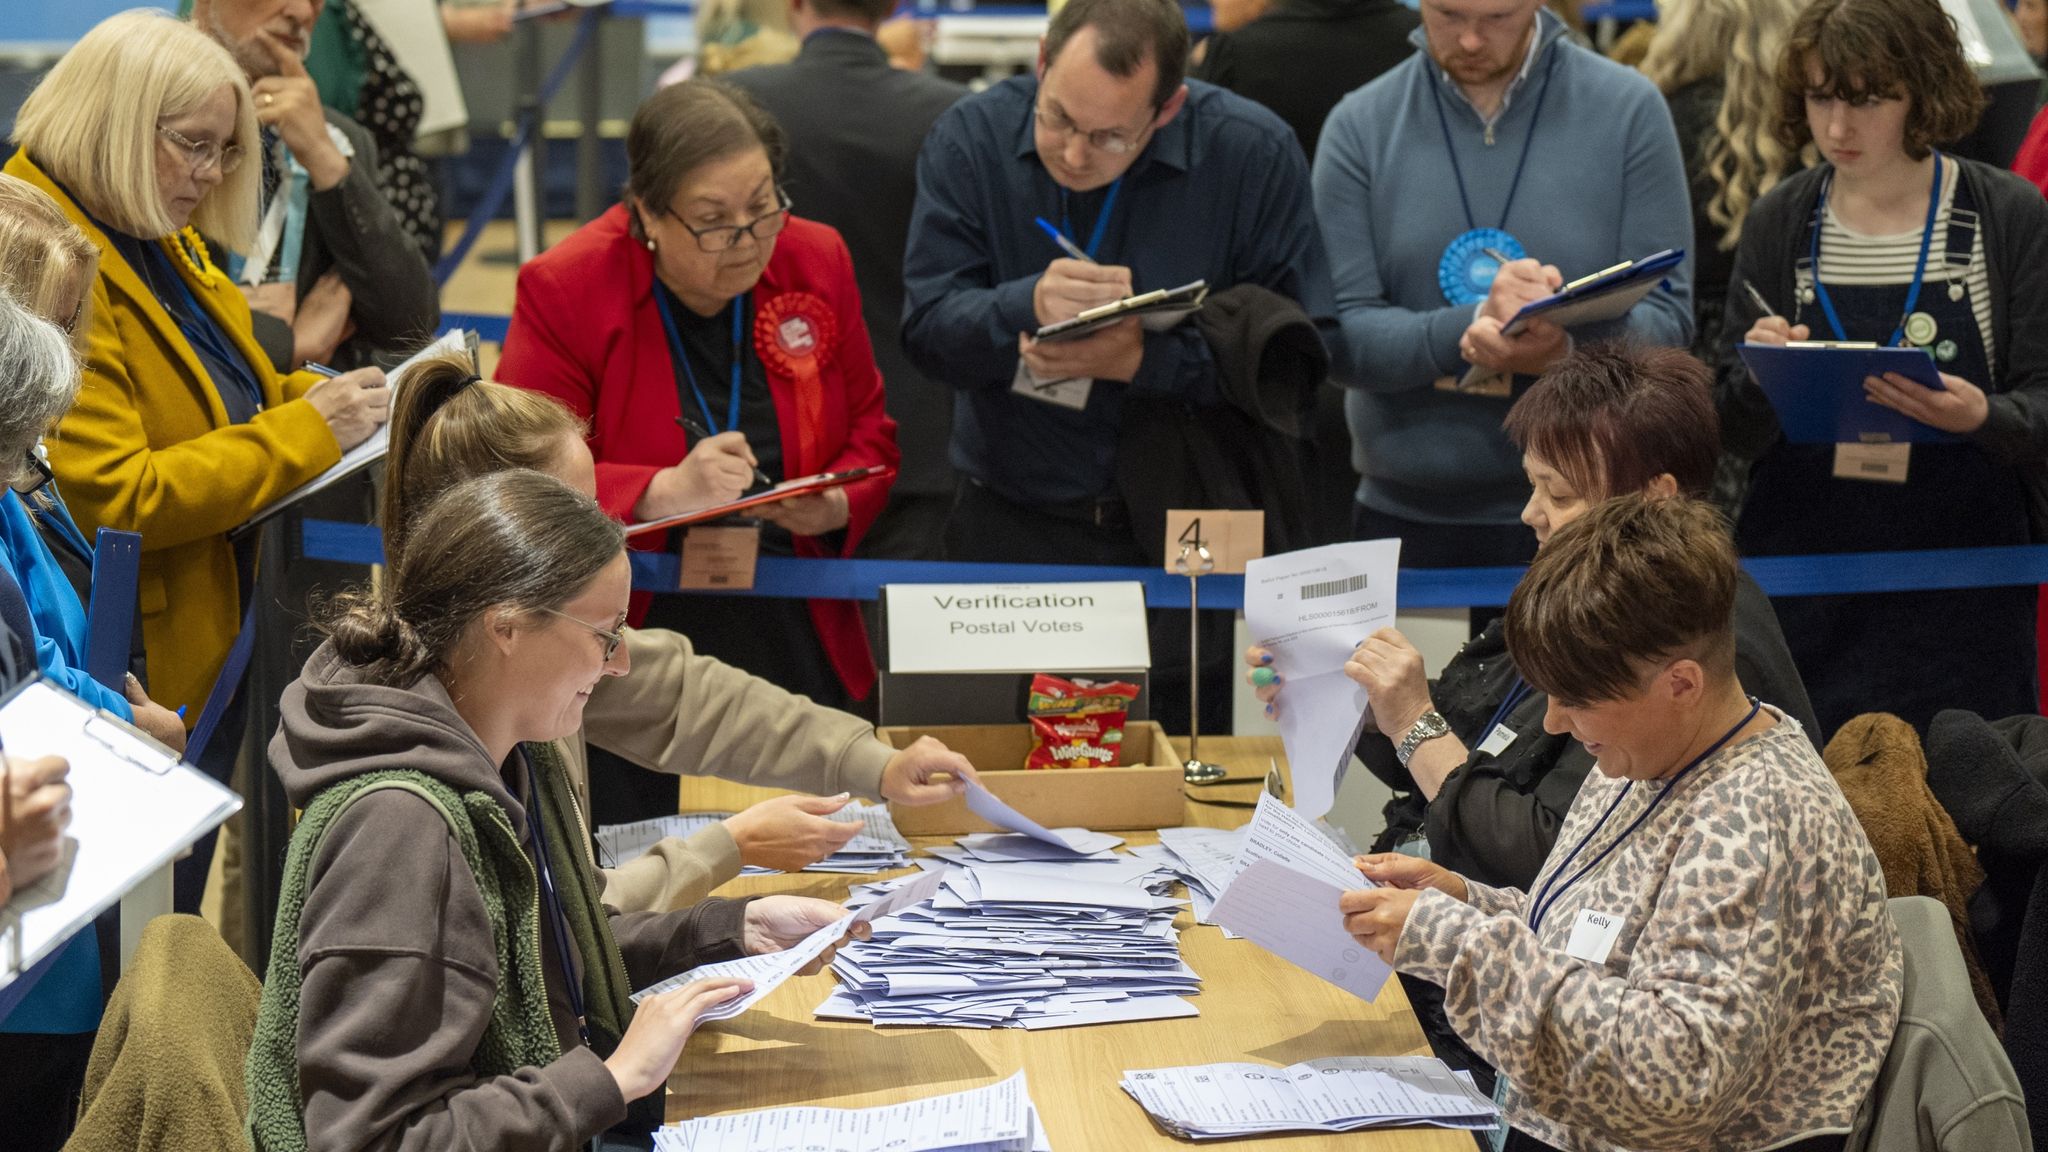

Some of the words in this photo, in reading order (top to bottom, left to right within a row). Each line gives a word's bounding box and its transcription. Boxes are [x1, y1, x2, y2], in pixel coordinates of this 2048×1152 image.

[1178, 517, 1208, 551] 4
[934, 593, 1095, 610] Verification
[950, 620, 1015, 635] Postal
[1023, 619, 1084, 633] Votes
[1587, 913, 1611, 929] Kelly
